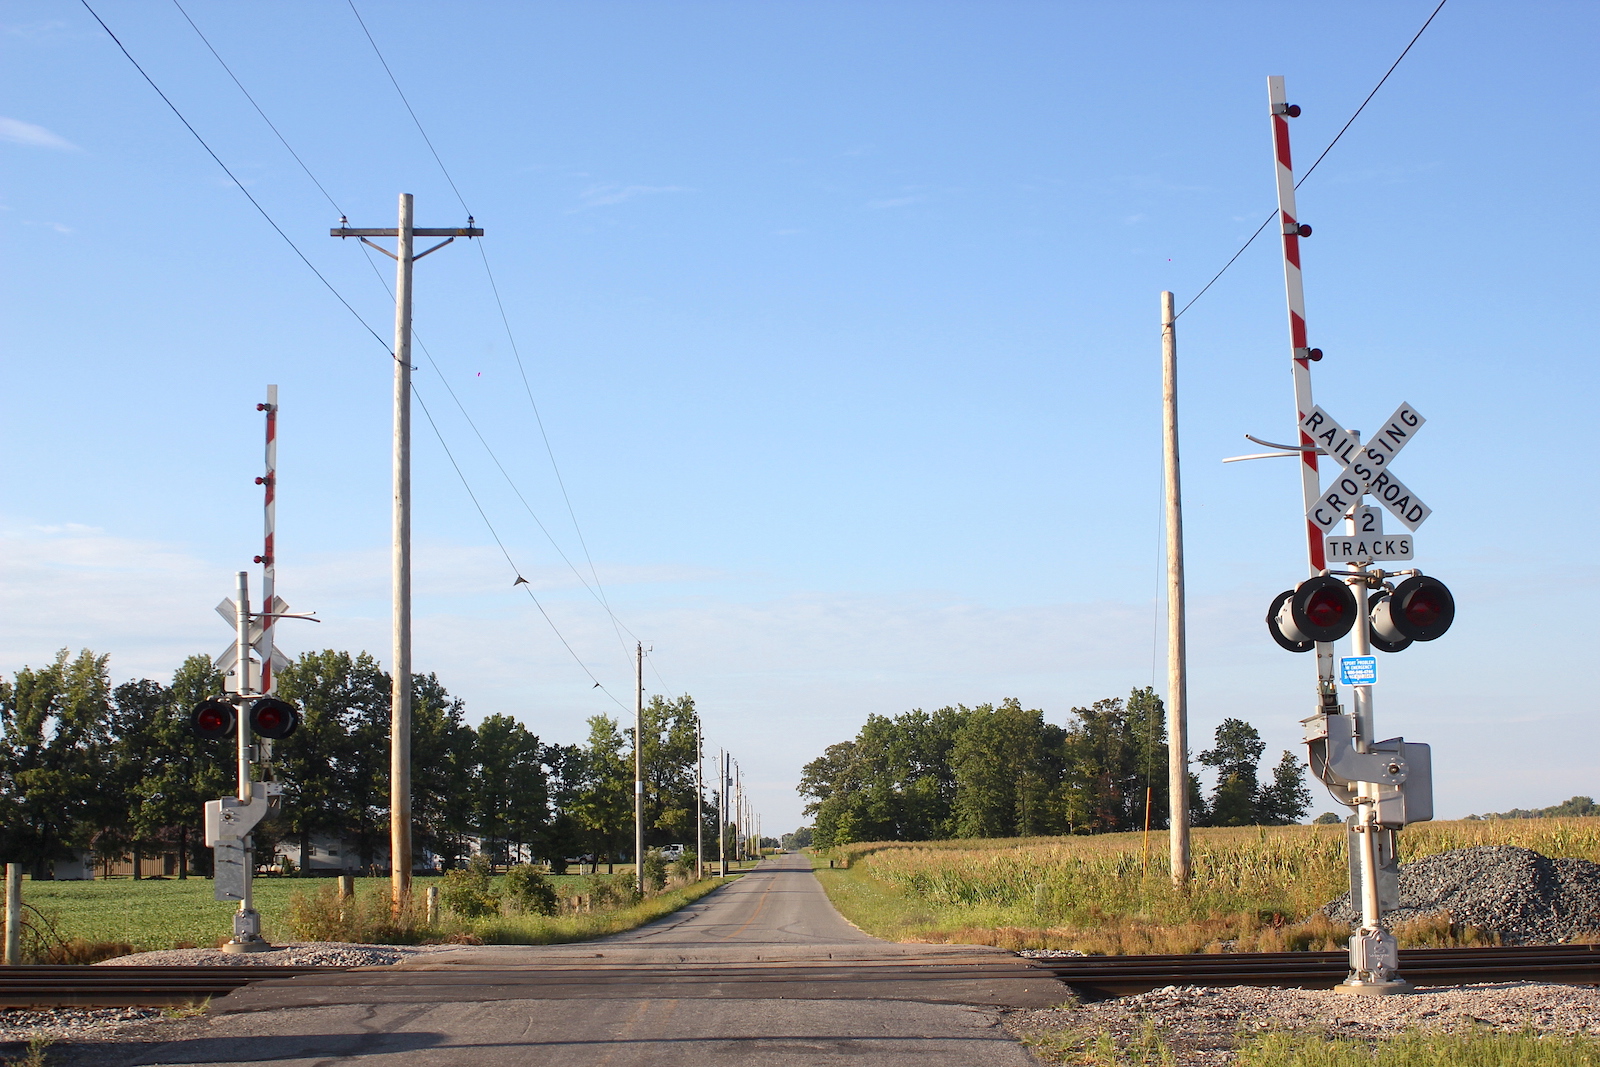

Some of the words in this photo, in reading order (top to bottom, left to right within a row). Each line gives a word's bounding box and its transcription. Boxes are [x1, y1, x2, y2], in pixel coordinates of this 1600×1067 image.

[1314, 410, 1418, 526] CROSSING
[1361, 513, 1375, 532] 2
[1329, 540, 1409, 557] TRACKS
